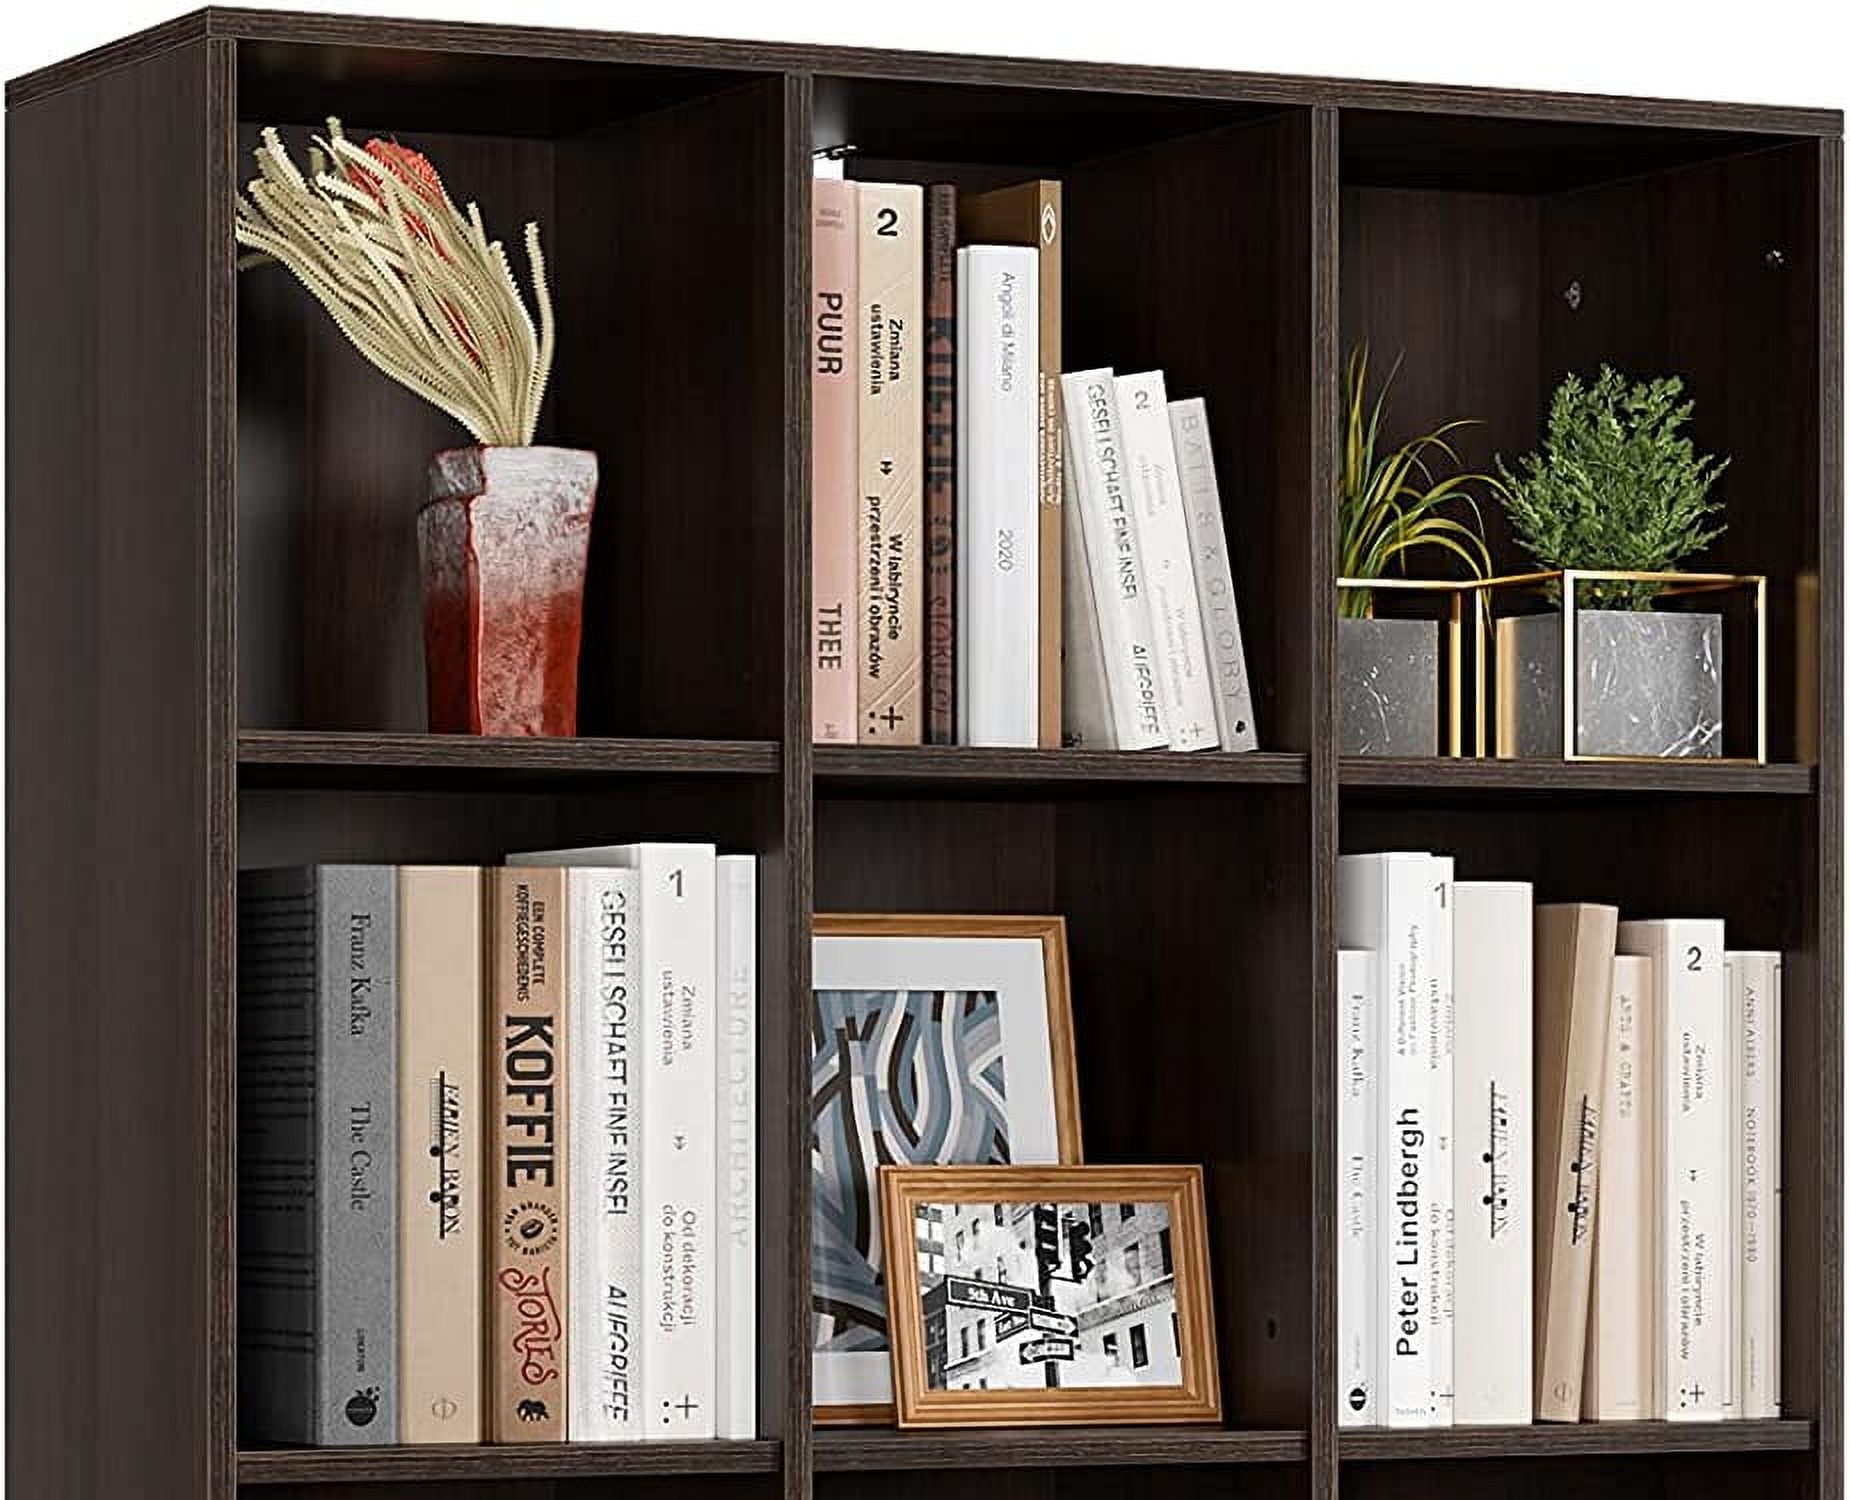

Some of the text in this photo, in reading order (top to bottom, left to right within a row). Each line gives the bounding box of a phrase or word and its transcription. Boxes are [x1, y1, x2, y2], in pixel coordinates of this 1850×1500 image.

[877, 207, 899, 238] 2
[870, 304, 886, 396] ustawienia
[889, 319, 904, 382] Zmiana
[1001, 322, 1016, 339] di
[817, 291, 844, 671] PUUR THEE
[866, 496, 884, 595] przestrzeni
[885, 534, 904, 641] W labiryncie
[998, 528, 1015, 573] 2020
[667, 869, 684, 898] 1
[1433, 882, 1447, 908] 1
[532, 901, 546, 986] EEN COMPLETE
[1687, 945, 1702, 972] 2
[350, 912, 372, 1210] Franz Kafka The Castle
[661, 970, 676, 1066] ustawienia
[680, 985, 698, 1051] Zmiana
[506, 1014, 554, 1188] KOFFIE
[659, 1203, 677, 1333] do konstrukcji
[679, 1210, 698, 1326] Od dekoracji
[1396, 1108, 1424, 1356] Peter Lindbergh
[500, 1266, 562, 1386] STORIES
